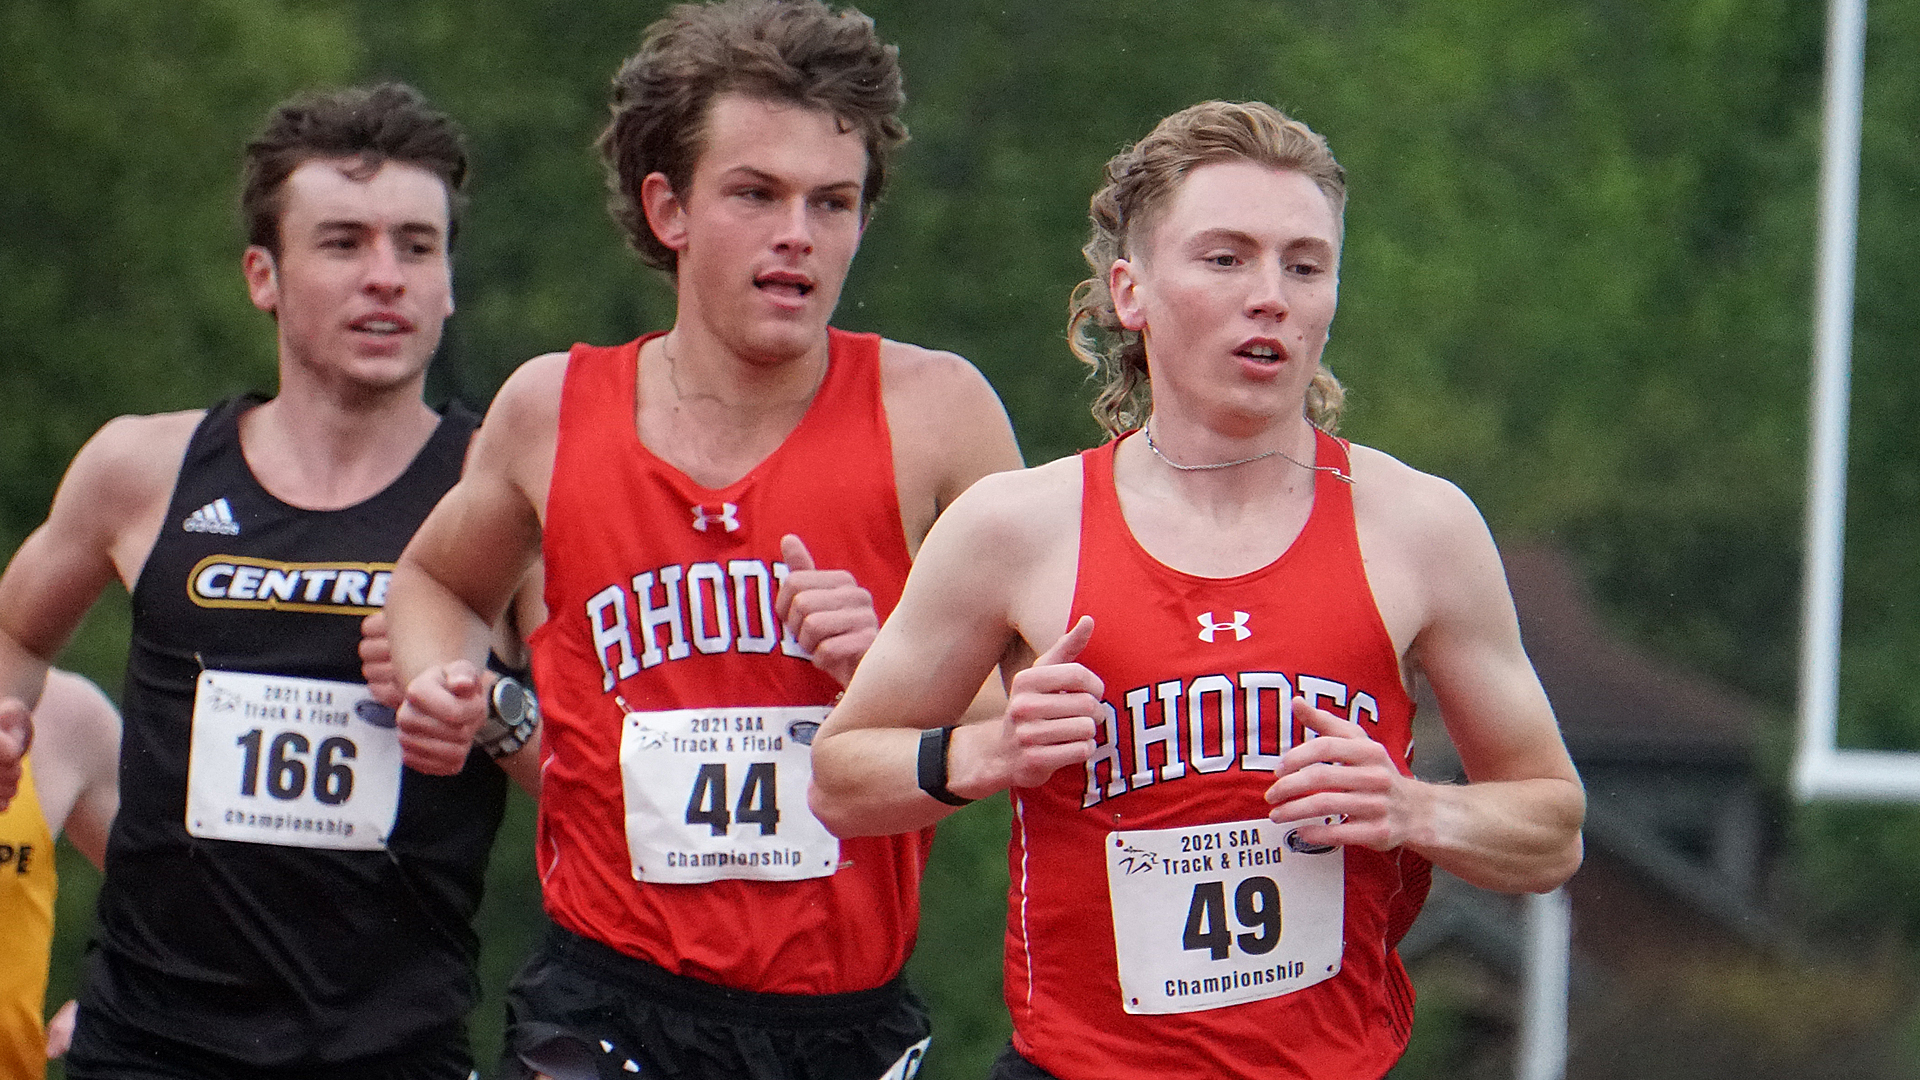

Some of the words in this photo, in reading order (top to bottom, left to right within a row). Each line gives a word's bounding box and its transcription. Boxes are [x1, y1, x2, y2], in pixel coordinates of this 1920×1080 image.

[195, 563, 393, 606] CENTRE
[585, 559, 814, 694] RHOD
[244, 703, 287, 719] Track
[310, 710, 349, 726] Field
[691, 717, 728, 733] 2021
[735, 716, 764, 732] SAA
[673, 737, 718, 752] Track
[726, 738, 734, 751] &
[743, 736, 783, 751] Field
[237, 729, 358, 806] 166
[685, 762, 780, 836] 44
[225, 810, 355, 836] Championship
[1181, 832, 1222, 853] 2021
[1229, 828, 1261, 847] SAA
[667, 850, 801, 867] Championship
[1163, 855, 1213, 875] Track
[1221, 852, 1231, 869] &
[1238, 847, 1282, 867] Field
[1182, 876, 1283, 961] 49
[1165, 961, 1305, 997] Championship
